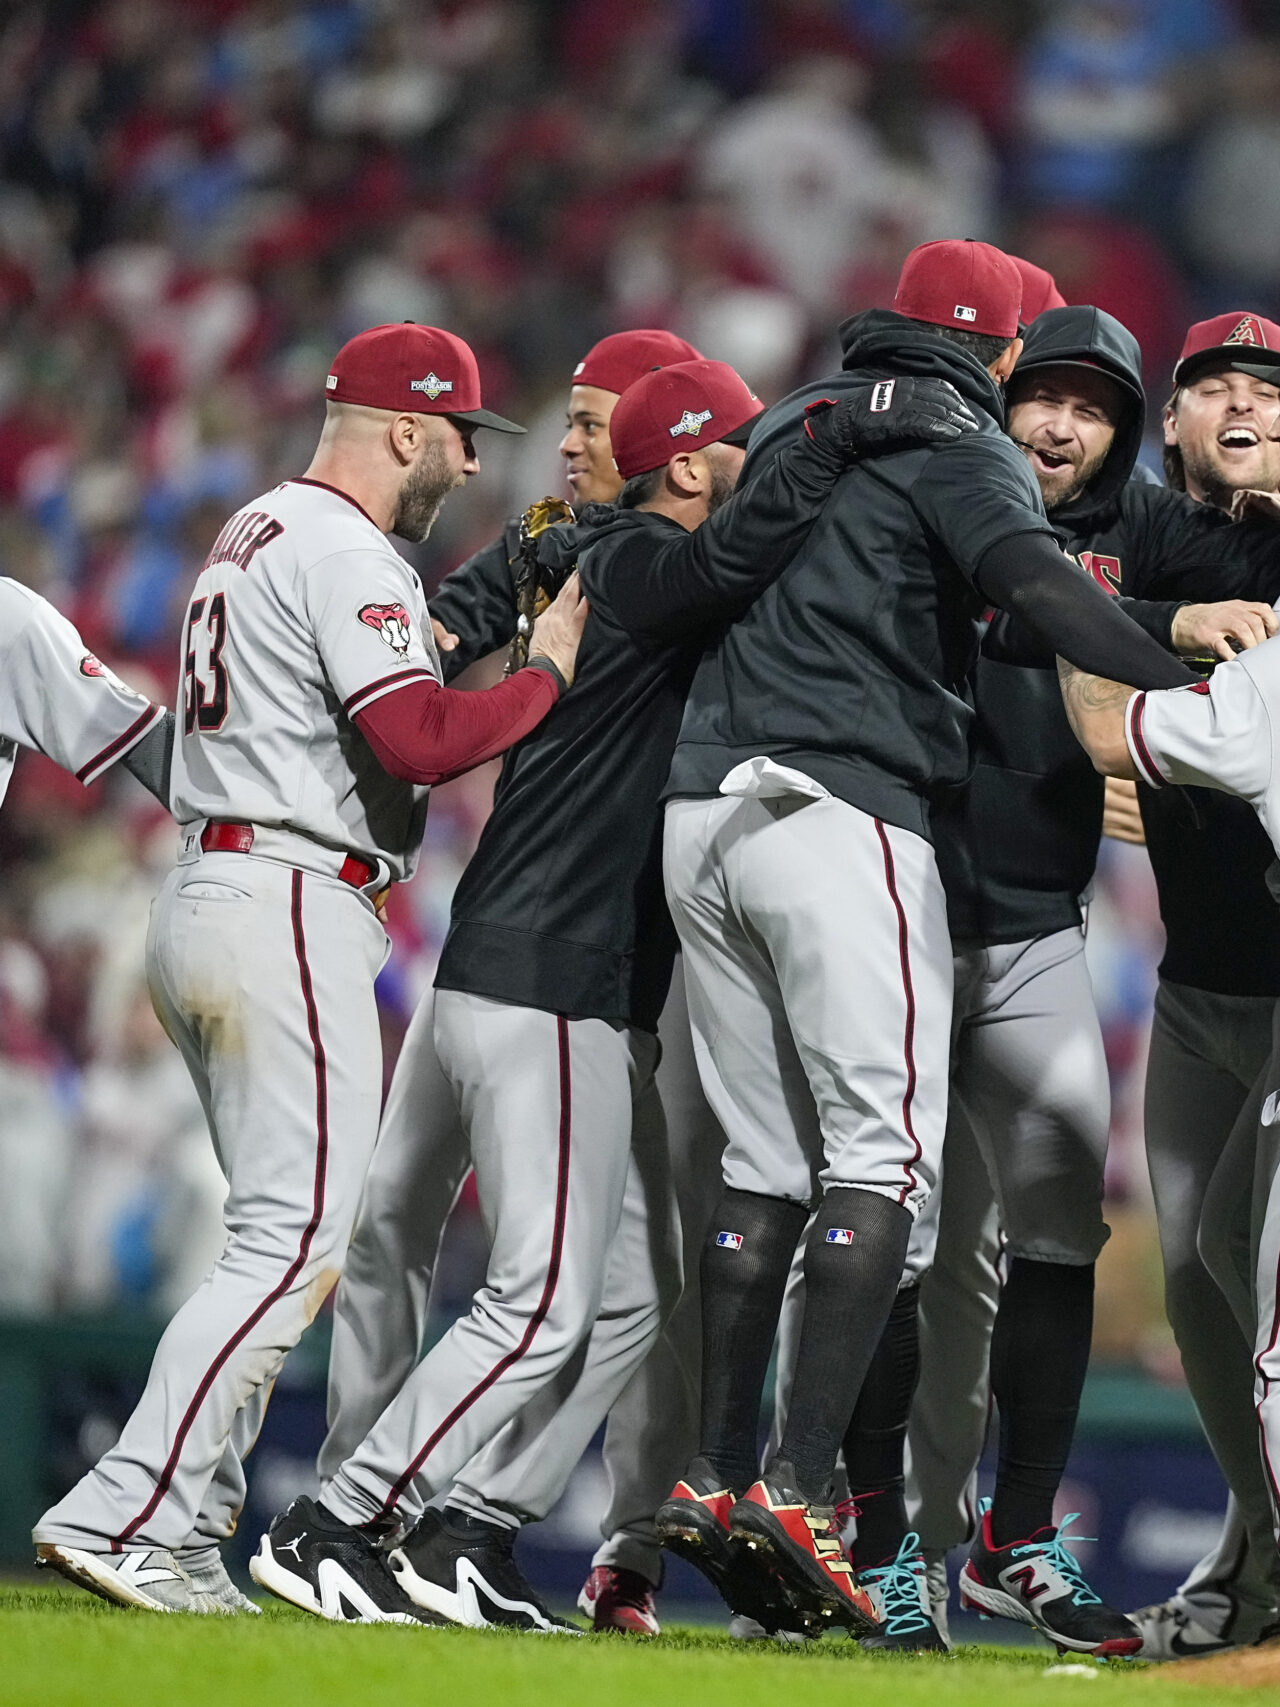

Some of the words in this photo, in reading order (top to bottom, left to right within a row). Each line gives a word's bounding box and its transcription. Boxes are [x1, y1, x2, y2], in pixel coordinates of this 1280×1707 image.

[412, 382, 453, 391] POSTSEASON
[875, 383, 892, 410] Franklin
[200, 511, 285, 573] ALKER
[184, 591, 230, 736] 53
